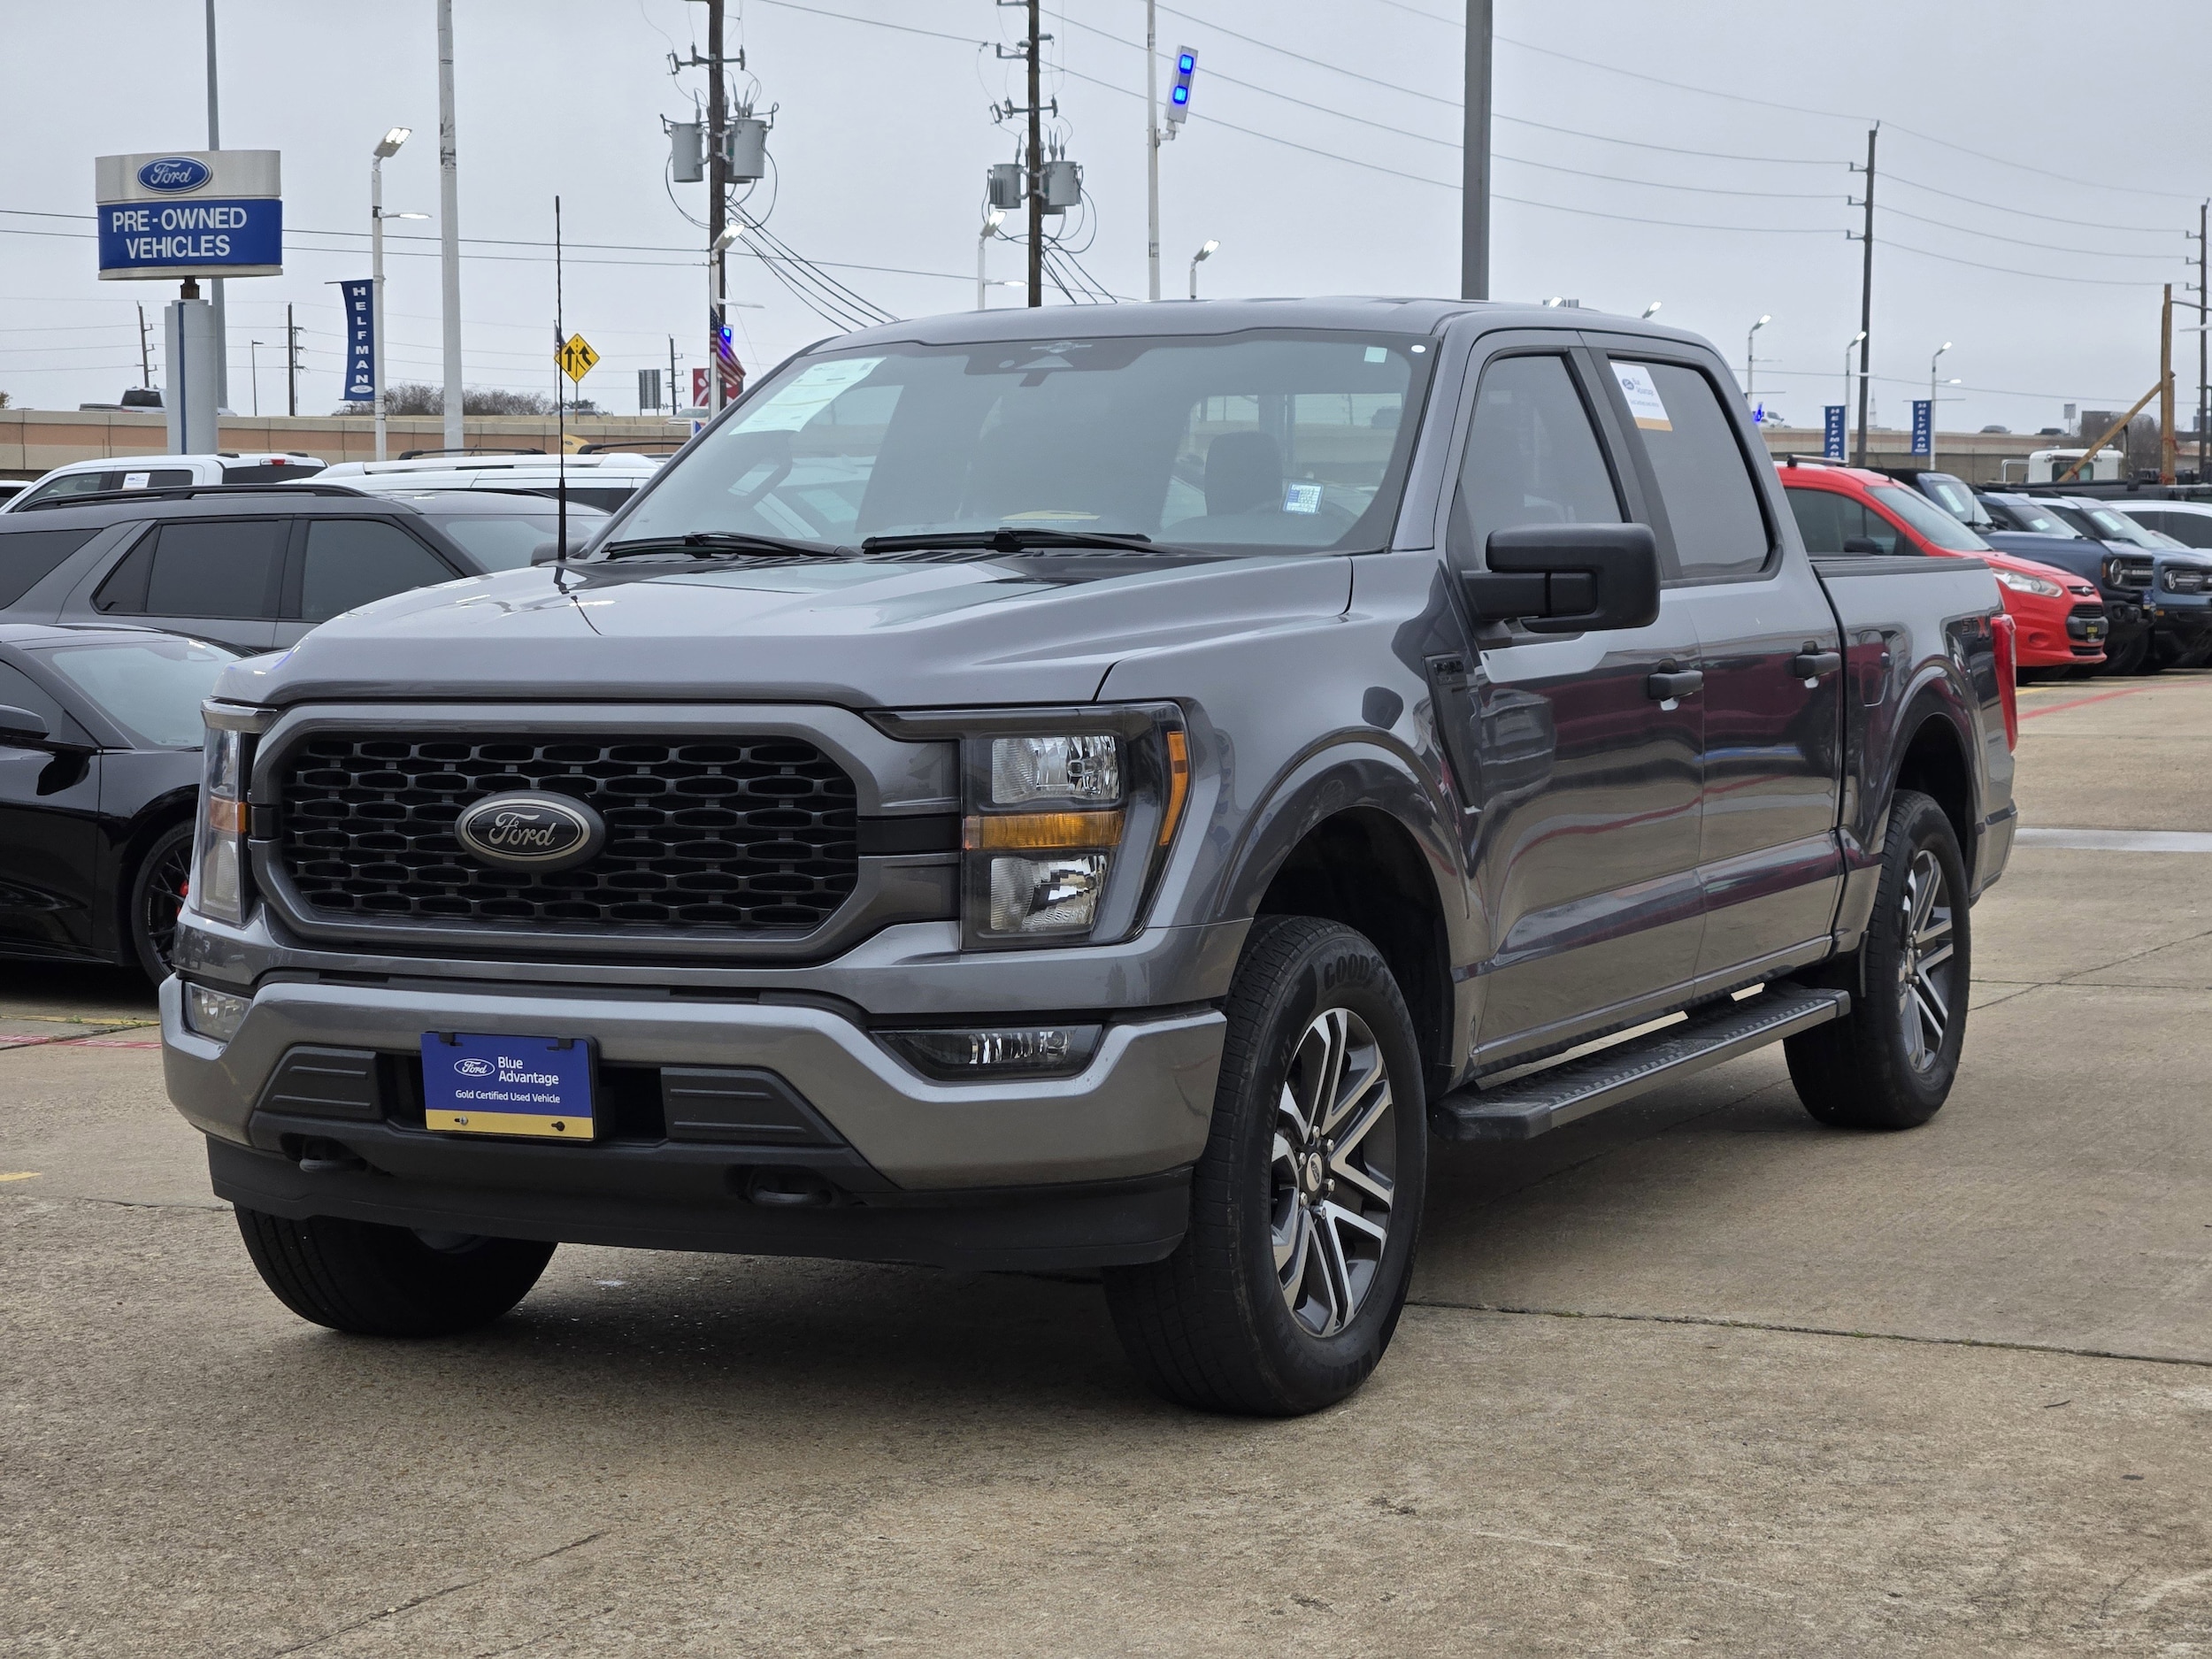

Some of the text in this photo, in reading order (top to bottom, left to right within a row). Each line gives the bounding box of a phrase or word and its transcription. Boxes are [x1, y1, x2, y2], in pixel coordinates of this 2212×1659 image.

[150, 162, 192, 185] Ford
[112, 207, 248, 233] PRE-OWNED
[126, 235, 231, 259] VEHICLES
[352, 287, 369, 384] HELFMAN
[1829, 408, 1840, 457] HELFMAN
[1916, 403, 1927, 449] HELFMAN
[488, 811, 557, 847] Ford
[462, 1061, 488, 1074] Ford
[497, 1056, 523, 1069] Blue
[498, 1071, 559, 1086] Advantage
[455, 1089, 560, 1103] Gold Certified Used Vehicle
